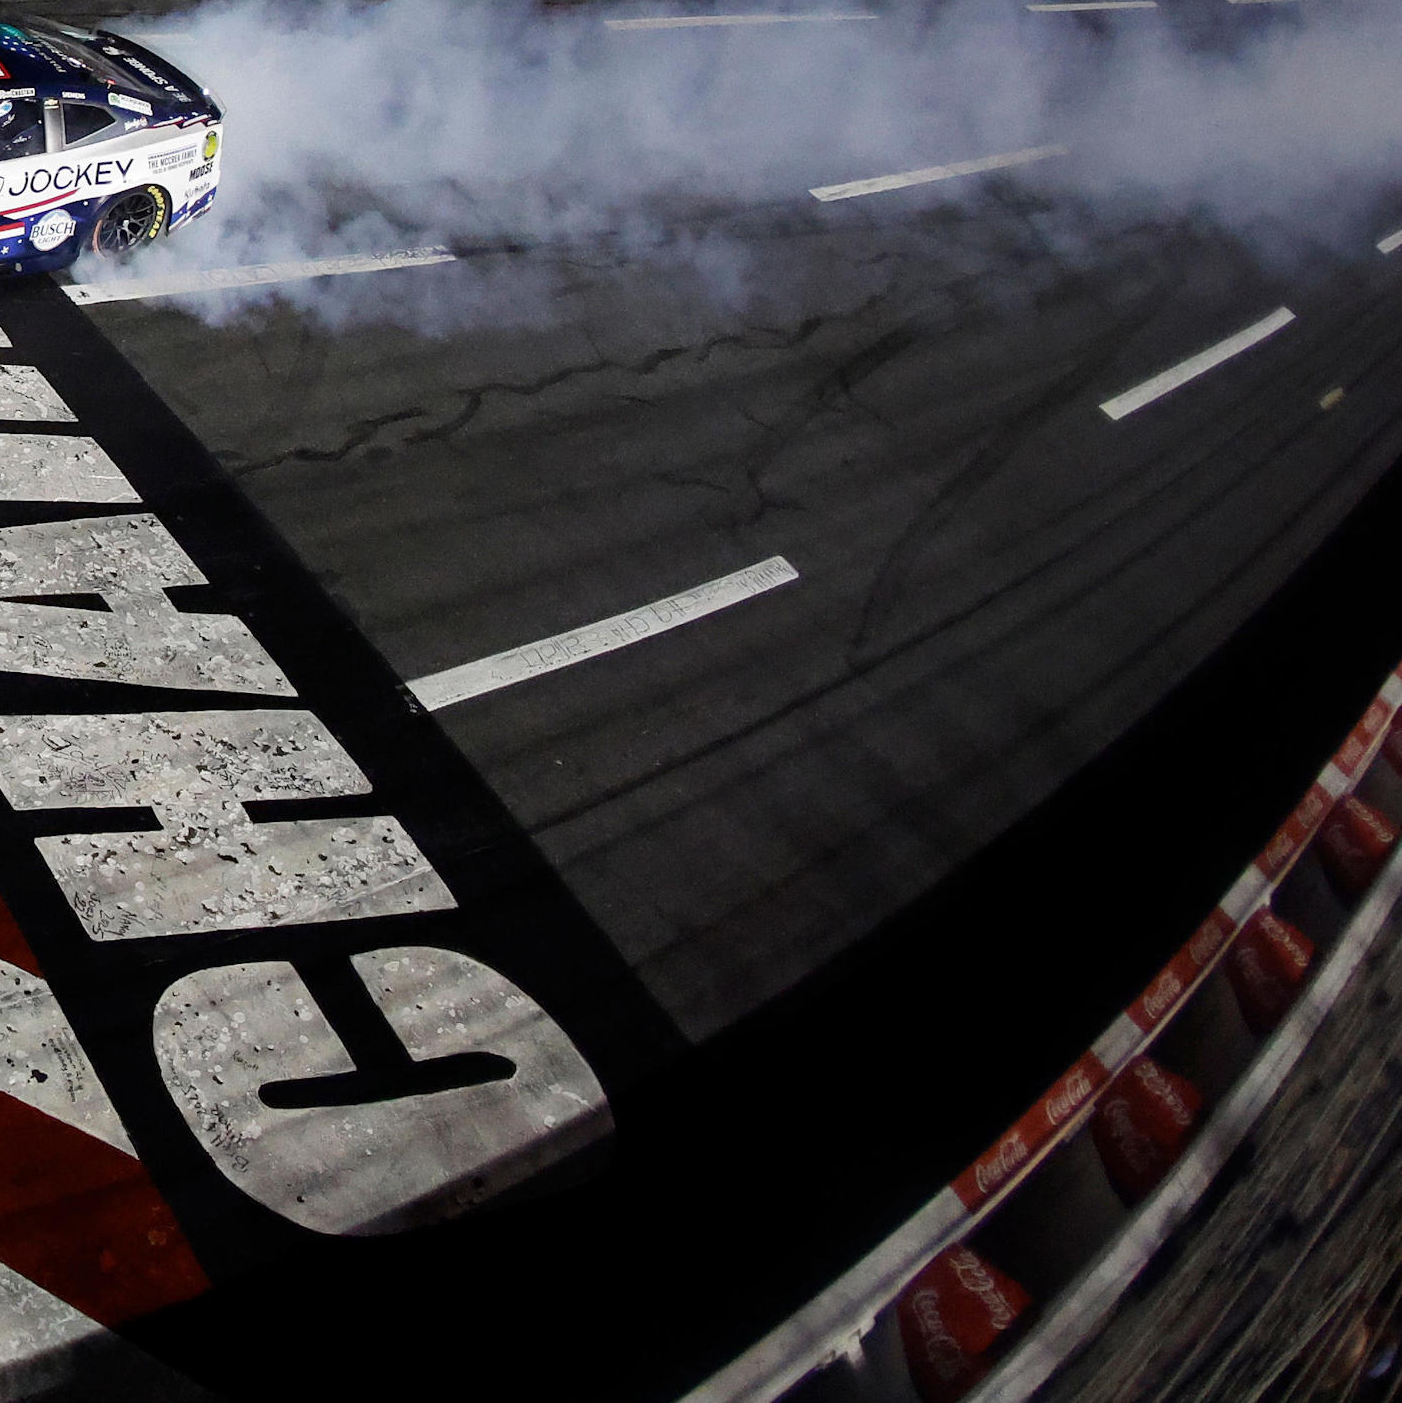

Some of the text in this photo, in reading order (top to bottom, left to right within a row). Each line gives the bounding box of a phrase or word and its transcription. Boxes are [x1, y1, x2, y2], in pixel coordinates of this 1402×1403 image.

[148, 160, 159, 170] THE
[189, 161, 214, 182] MOOSE
[8, 158, 135, 198] JOCKEY
[147, 185, 166, 239] GOODYEAR
[31, 221, 76, 240] BUSCH
[37, 234, 63, 246] LIGHT
[975, 1134, 1029, 1195] Coca-Cola
